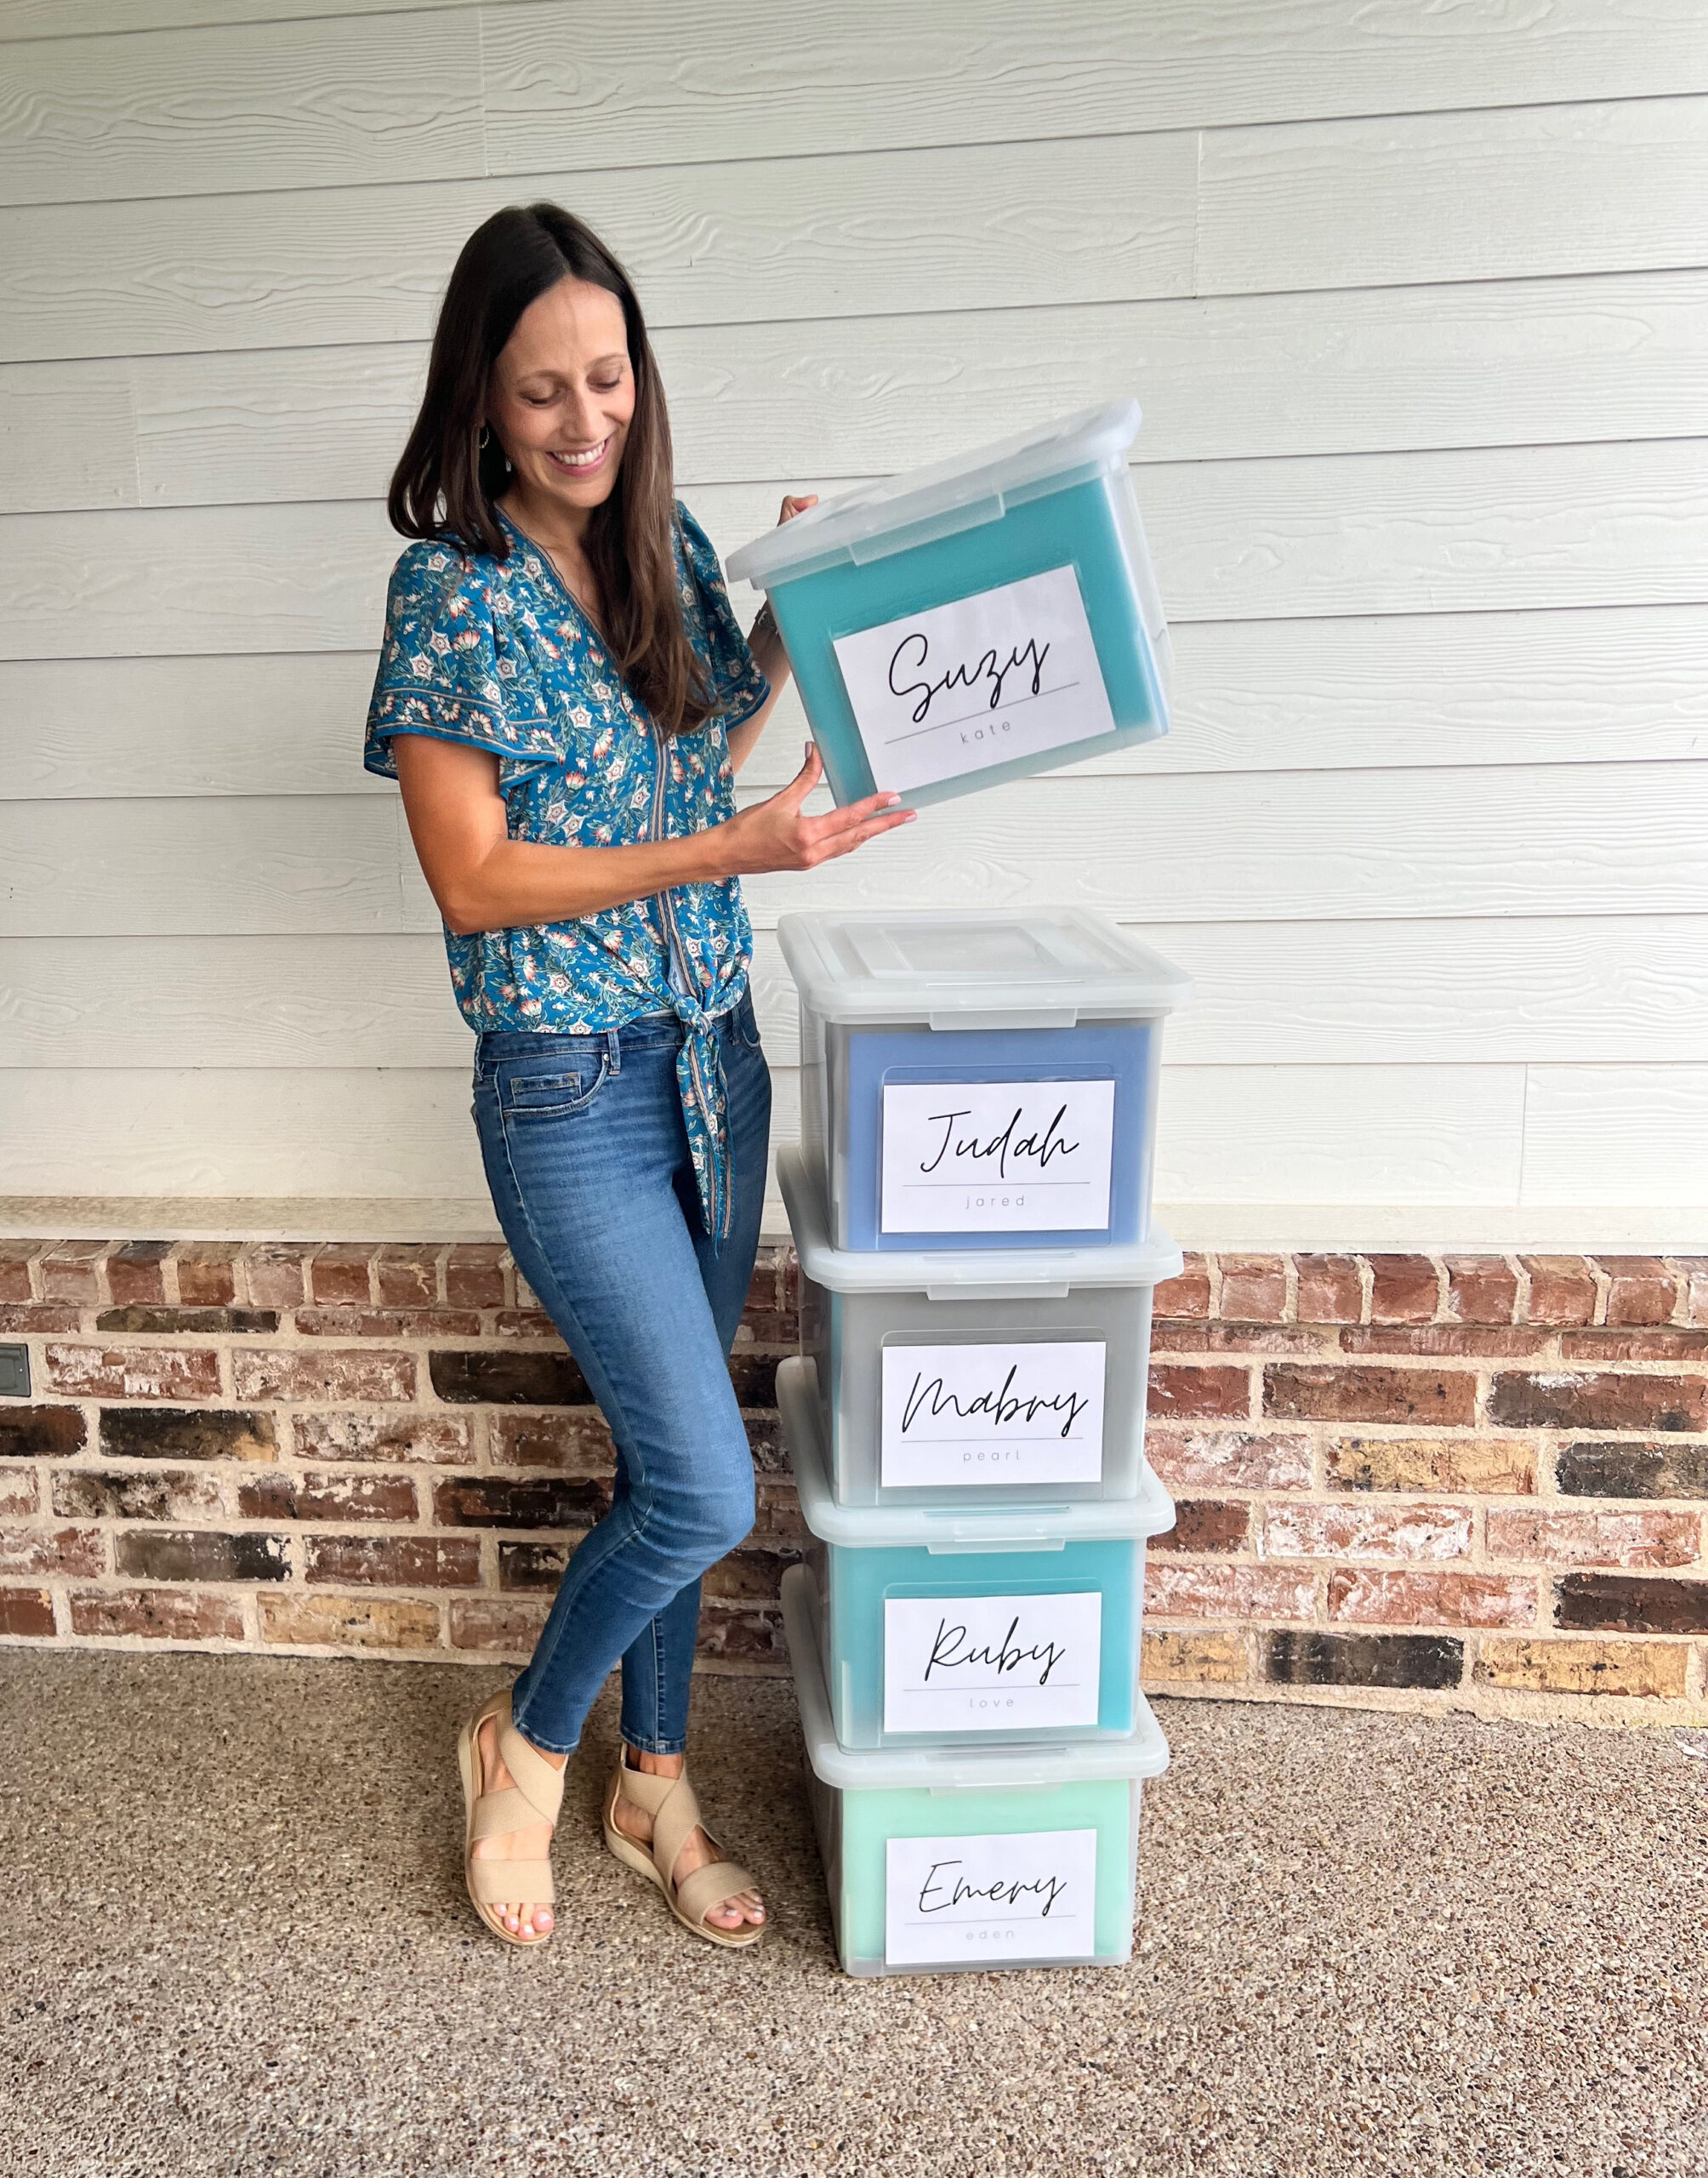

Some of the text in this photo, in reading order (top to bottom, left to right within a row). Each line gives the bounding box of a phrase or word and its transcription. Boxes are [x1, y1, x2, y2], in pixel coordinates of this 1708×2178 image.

[889, 634, 1050, 723] Suzy
[960, 720, 1011, 744] kate
[919, 1103, 1079, 1179] Judah
[965, 1194, 1025, 1210] jared
[902, 1364, 1089, 1438] Mabry
[963, 1449, 1021, 1463] pearl
[924, 1616, 1066, 1685] Ruby
[969, 1697, 1015, 1708] love
[918, 1860, 1068, 1917] Emery
[965, 1928, 1015, 1941] eden
